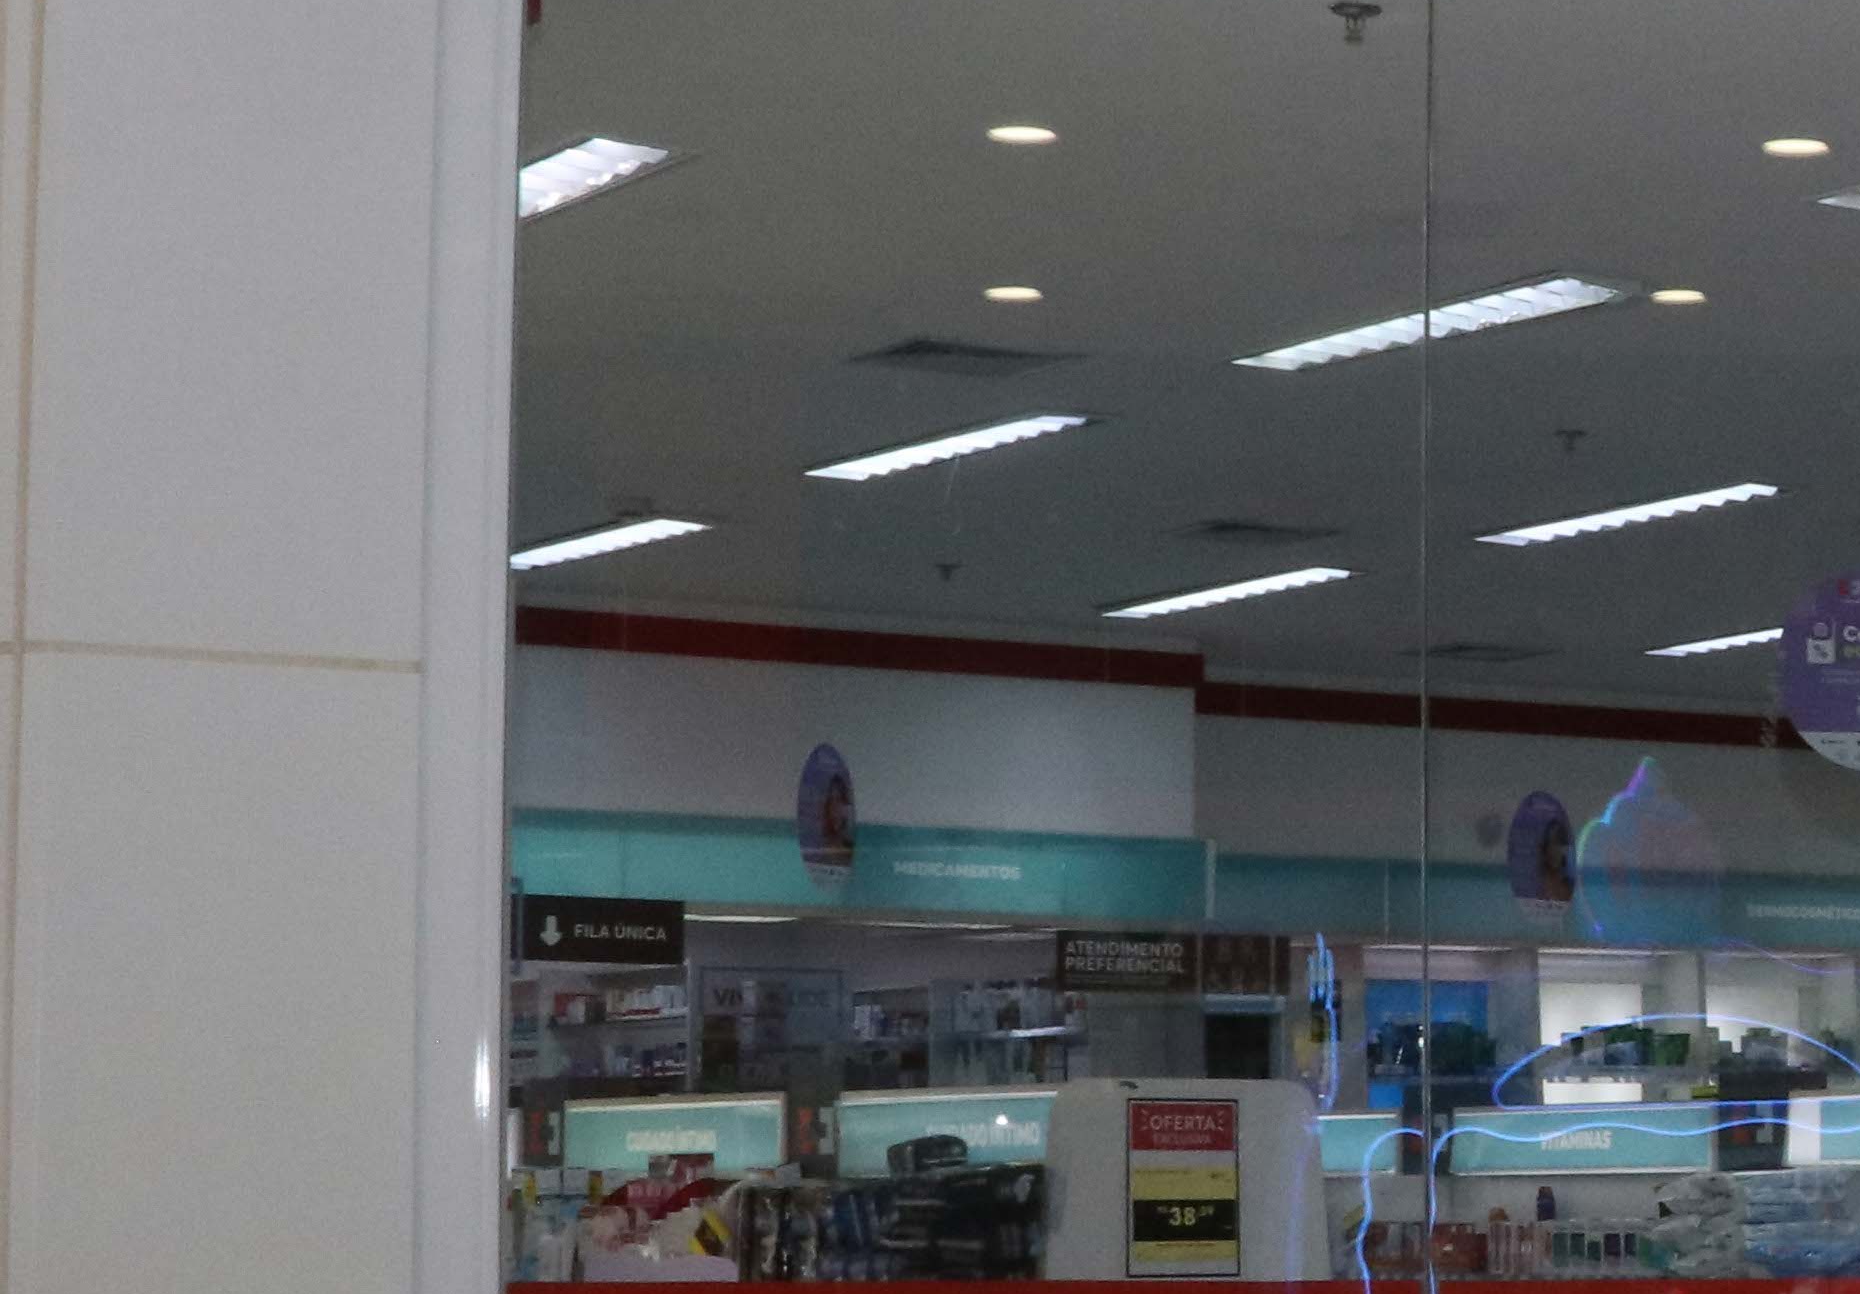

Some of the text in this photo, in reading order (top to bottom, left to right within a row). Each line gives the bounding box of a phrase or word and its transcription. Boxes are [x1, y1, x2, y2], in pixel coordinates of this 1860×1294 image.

[893, 860, 1022, 881] MEDICAMENTOS
[573, 921, 667, 942] FILA ÚNICA
[1065, 938, 1184, 958] ATENDIMENTO
[1065, 954, 1185, 973] PREFERENCIAL
[1148, 1113, 1215, 1133] OFERTA
[1540, 1129, 1613, 1151] VITAMINAS
